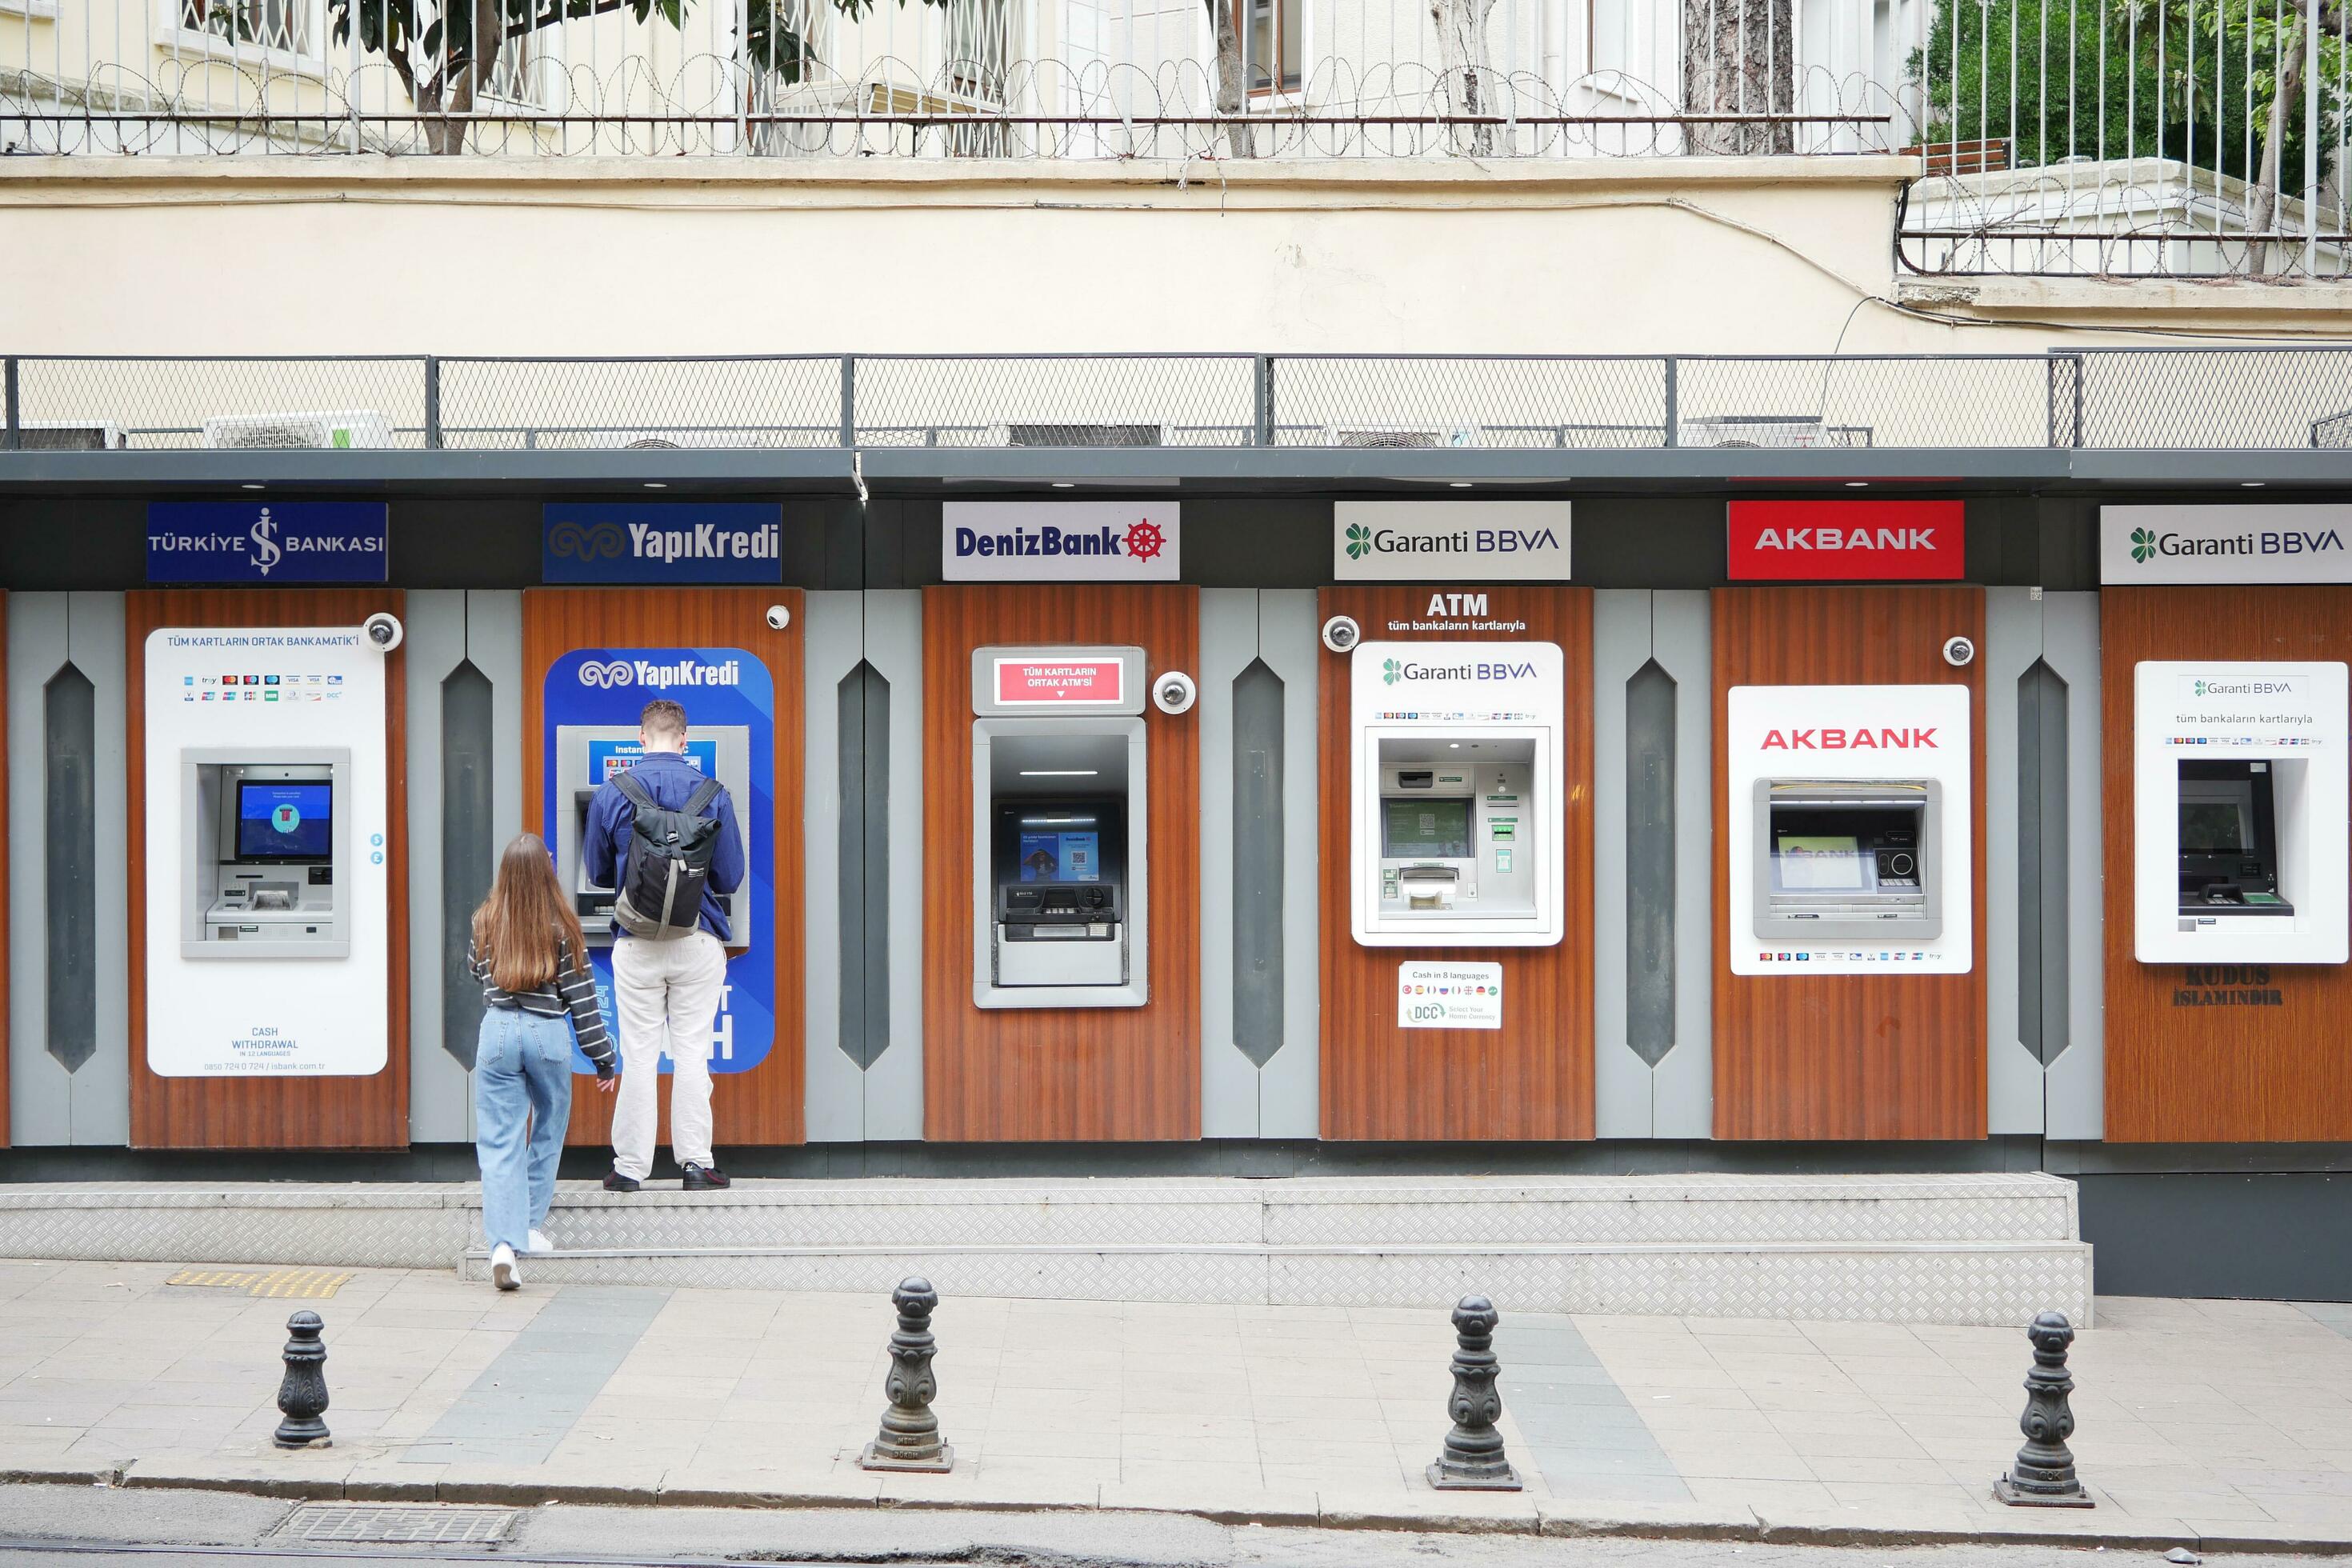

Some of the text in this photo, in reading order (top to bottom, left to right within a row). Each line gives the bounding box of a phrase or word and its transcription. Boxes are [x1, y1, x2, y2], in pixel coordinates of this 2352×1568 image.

[149, 532, 245, 551] TÜRKİYE
[286, 537, 383, 551] BANKASI
[628, 523, 778, 563] YapıKredi
[956, 526, 1121, 556] DenizBank
[1374, 528, 1559, 552] Garanti BBVA
[1754, 528, 1937, 550] AKBANK
[2159, 530, 2344, 555] Garanti BBVA
[1426, 594, 1487, 616] ATM
[1388, 621, 1526, 632] tüm bankaların kartlarıyla
[167, 635, 190, 646] TÜM
[192, 636, 250, 646] KARTLARIN
[252, 636, 285, 646] ORTAK
[634, 661, 738, 689] YapıKredi
[1022, 667, 1097, 677] TÜM KARTLARIN
[1404, 662, 1537, 680] Garanti BBVA
[1027, 678, 1060, 686] ORTAK
[2208, 682, 2291, 694] Garanti BBVA
[2177, 714, 2313, 726] tüm bankaların kartlarıyla
[1760, 728, 1938, 750] AKBANK
[1450, 972, 1489, 980] languages
[1415, 1006, 1438, 1019] DCC
[252, 1028, 278, 1036] CASH
[232, 1040, 298, 1049] WITHDRAWAL
